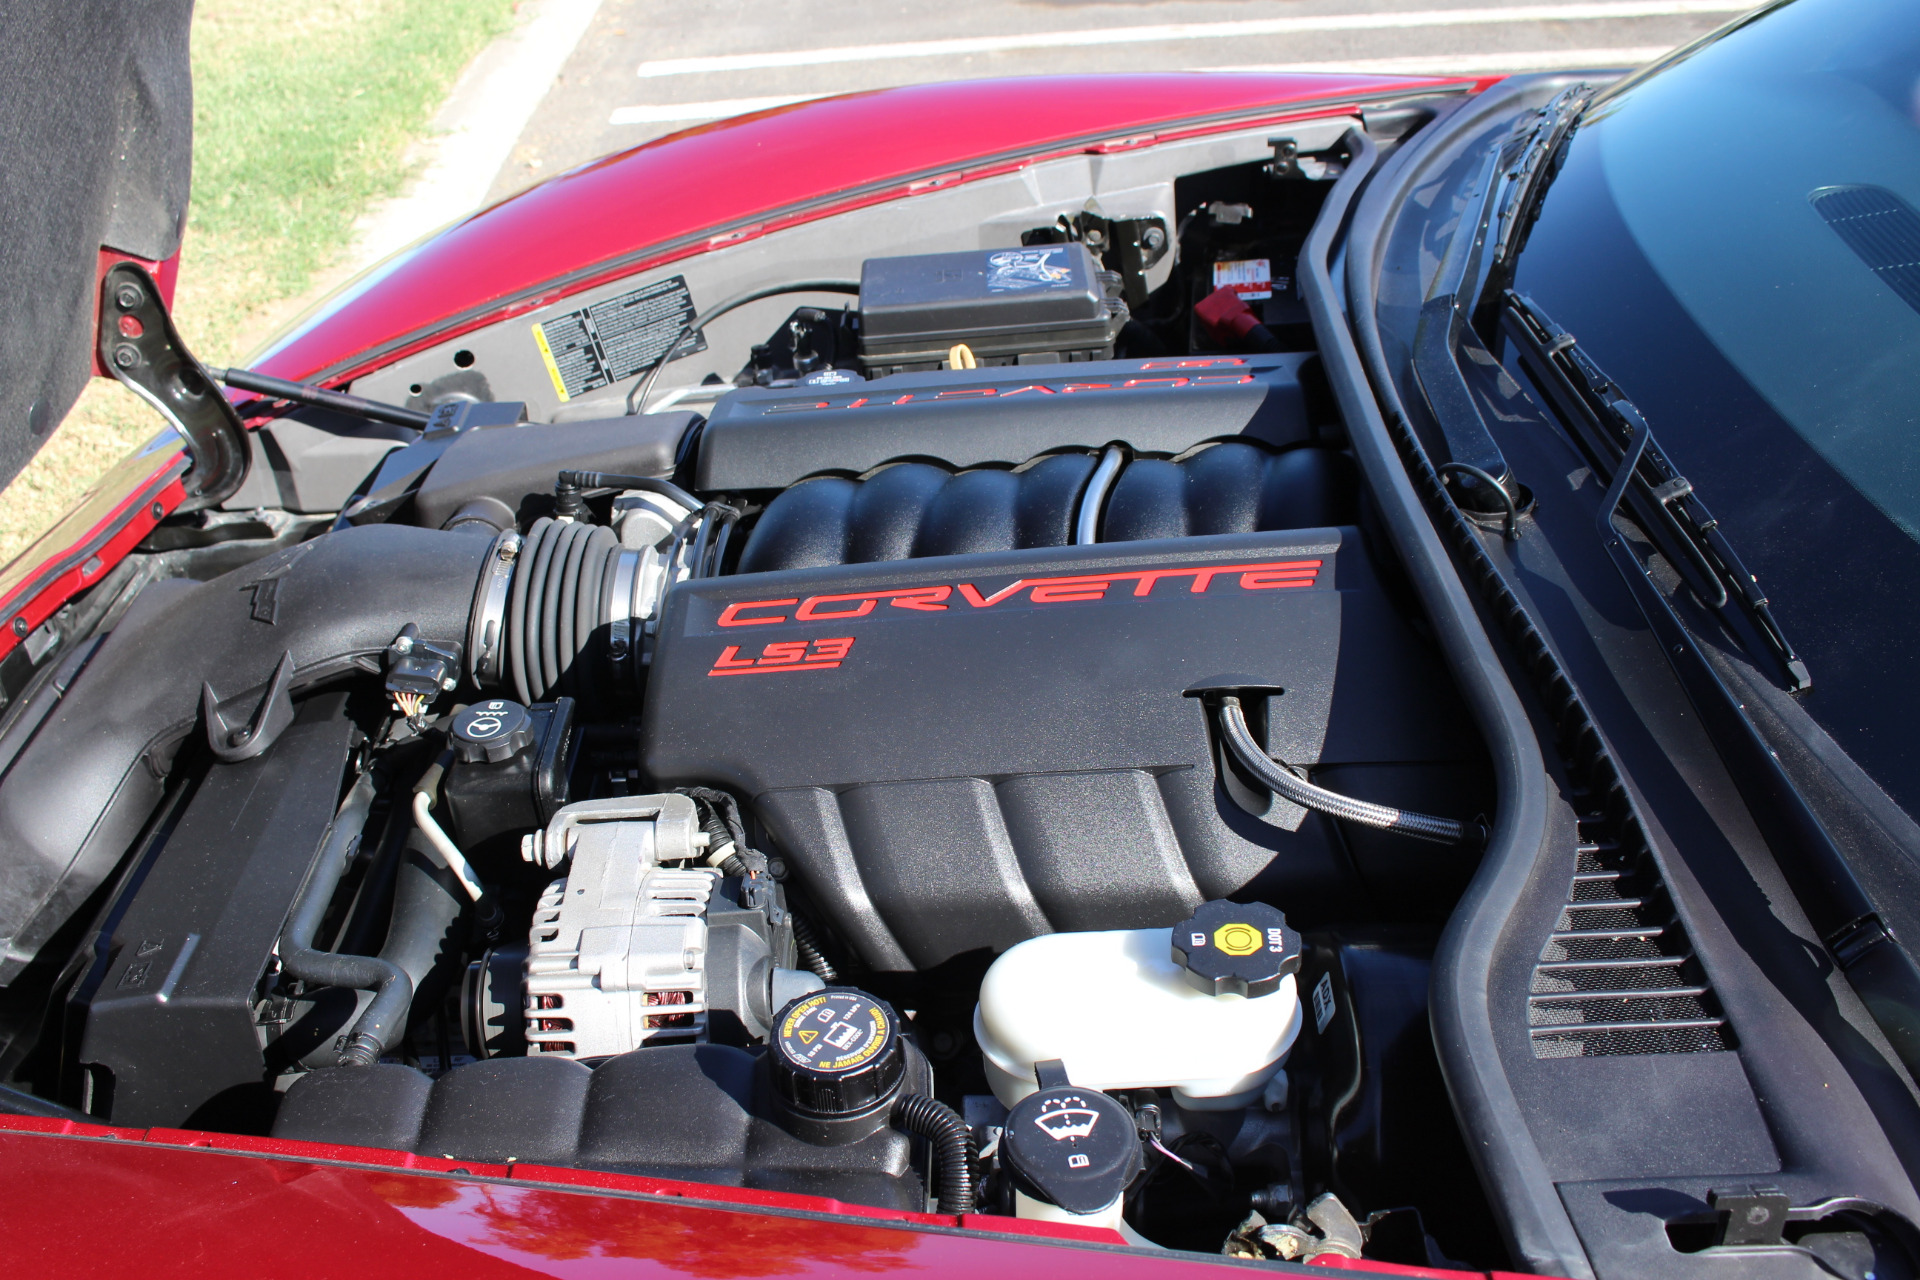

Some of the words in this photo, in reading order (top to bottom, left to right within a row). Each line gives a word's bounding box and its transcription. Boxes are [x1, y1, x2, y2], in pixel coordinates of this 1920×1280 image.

[717, 560, 1323, 627] CORVETTE
[709, 636, 856, 675] LS3
[1267, 927, 1283, 948] DOT
[1269, 945, 1284, 954] 3
[783, 1017, 797, 1038] NEVER
[791, 1003, 811, 1019] OPEN
[807, 996, 827, 1008] HOT!
[818, 1060, 832, 1069] NE
[832, 1054, 865, 1069] JAMAIS
[862, 1035, 885, 1057] OUVRIR
